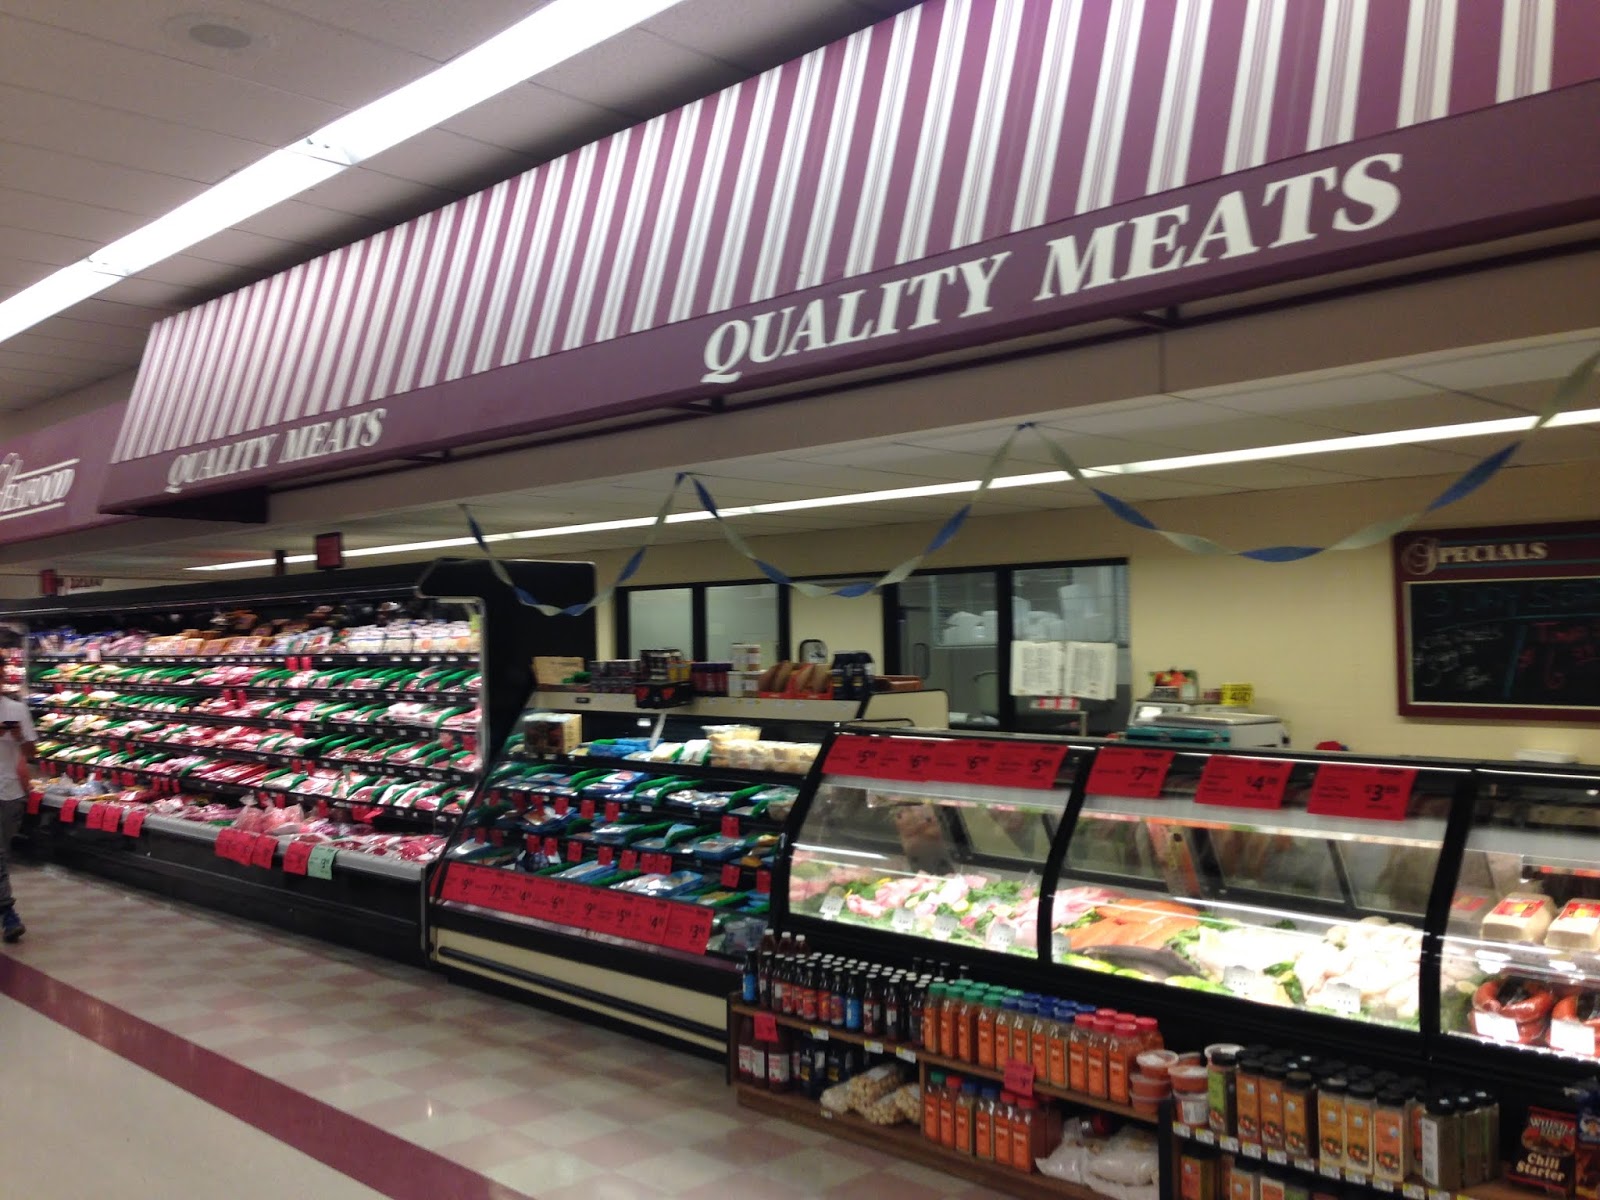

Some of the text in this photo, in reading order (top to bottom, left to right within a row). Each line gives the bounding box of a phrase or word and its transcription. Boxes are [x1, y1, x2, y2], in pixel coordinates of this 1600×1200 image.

[701, 152, 1403, 385] QUALITY MEATS
[164, 408, 387, 494] QUALITY MEATS
[1516, 1160, 1566, 1182] Starter
